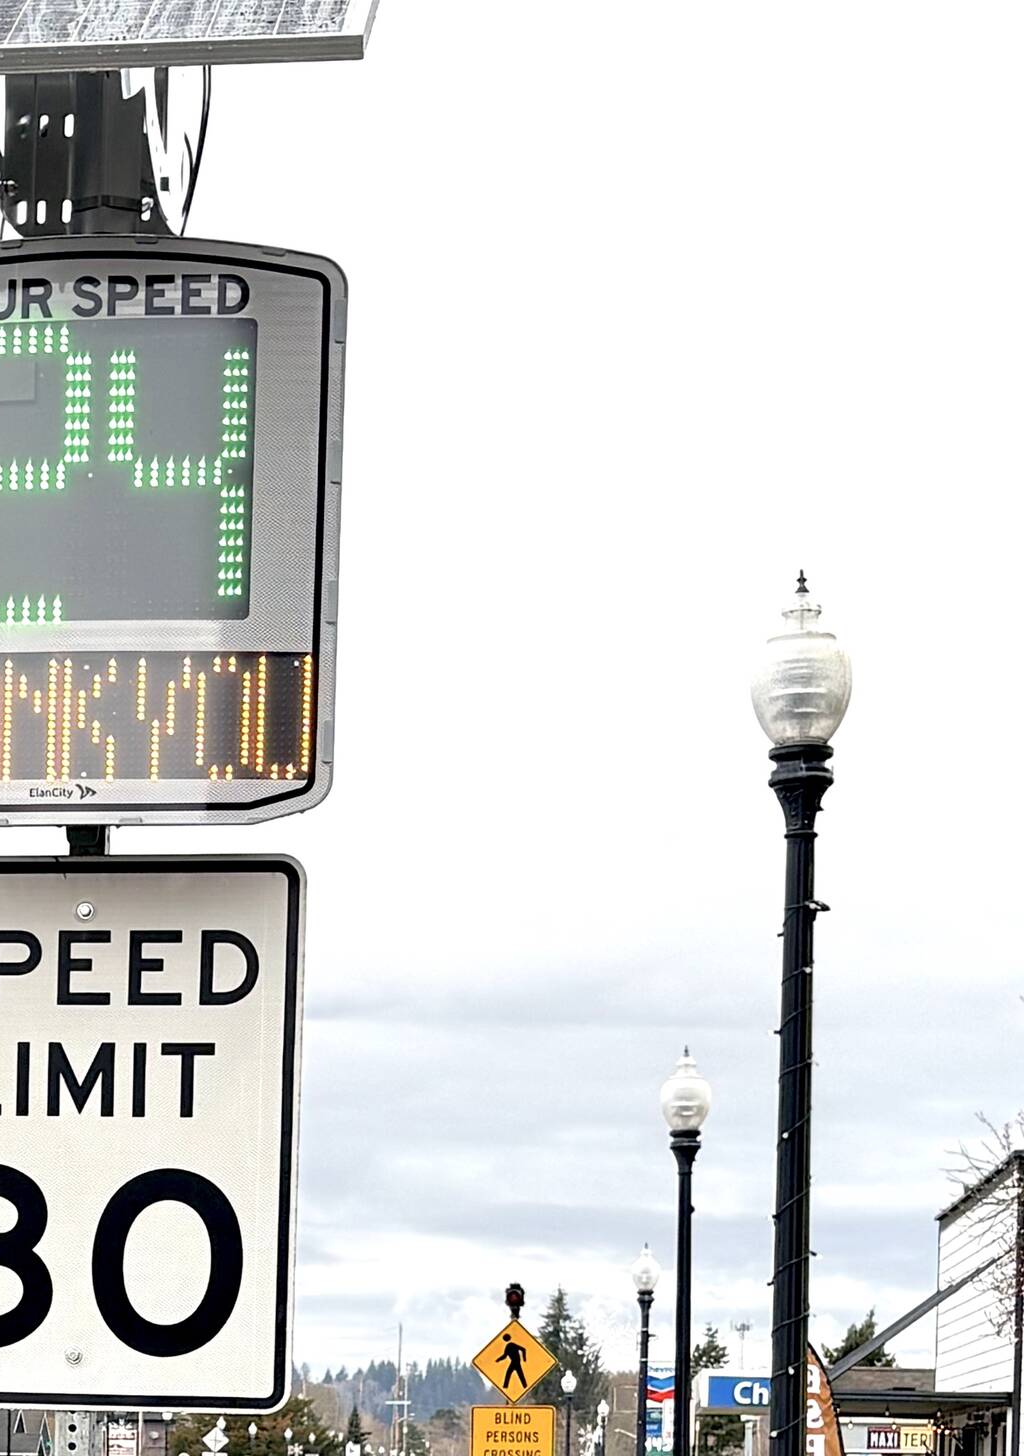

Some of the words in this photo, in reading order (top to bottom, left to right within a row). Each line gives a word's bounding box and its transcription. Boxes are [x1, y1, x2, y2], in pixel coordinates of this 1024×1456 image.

[72, 274, 250, 317] SPEED
[29, 787, 73, 799] ElanCity
[495, 1411, 531, 1425] BLIND
[486, 1430, 539, 1443] PERSONS
[870, 1432, 898, 1447] MAXI
